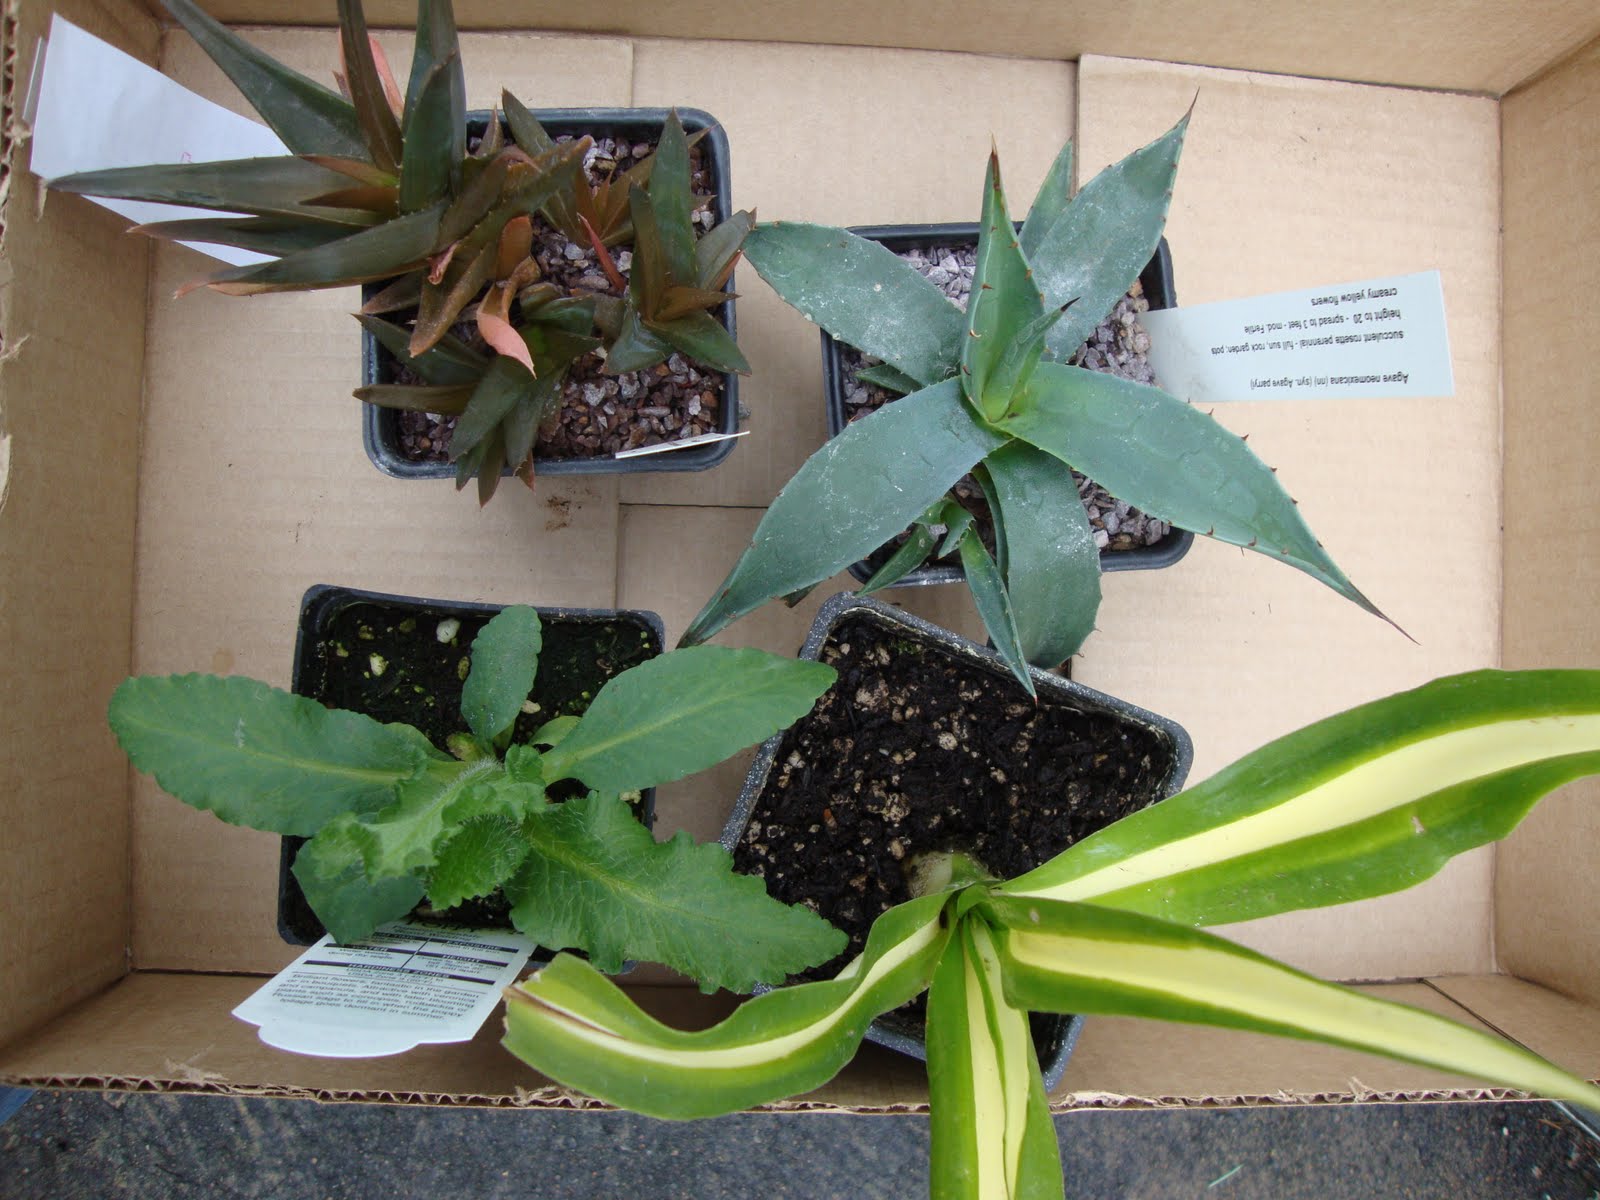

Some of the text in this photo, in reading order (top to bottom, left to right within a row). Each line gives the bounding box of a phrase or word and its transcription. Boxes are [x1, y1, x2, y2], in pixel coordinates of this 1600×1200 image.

[1311, 288, 1398, 306] creamy yellow flowers
[1365, 312, 1372, 321] to
[1374, 308, 1401, 321] height
[1288, 320, 1302, 330] feet
[1303, 320, 1308, 329] 3
[1310, 319, 1317, 327] to
[1319, 314, 1344, 327] spread
[1244, 325, 1264, 335] Fertile
[1266, 323, 1282, 332] mod.
[1300, 335, 1333, 349] perennial
[1335, 335, 1362, 345] rosette
[1364, 331, 1404, 343] succulent
[1211, 345, 1224, 355] pots
[1252, 343, 1265, 352] rock
[1283, 341, 1294, 350] full
[1273, 377, 1293, 388] Agave
[1330, 376, 1380, 385] neomexicana
[1383, 372, 1409, 384] Agave
[1250, 378, 1271, 390] parryi)
